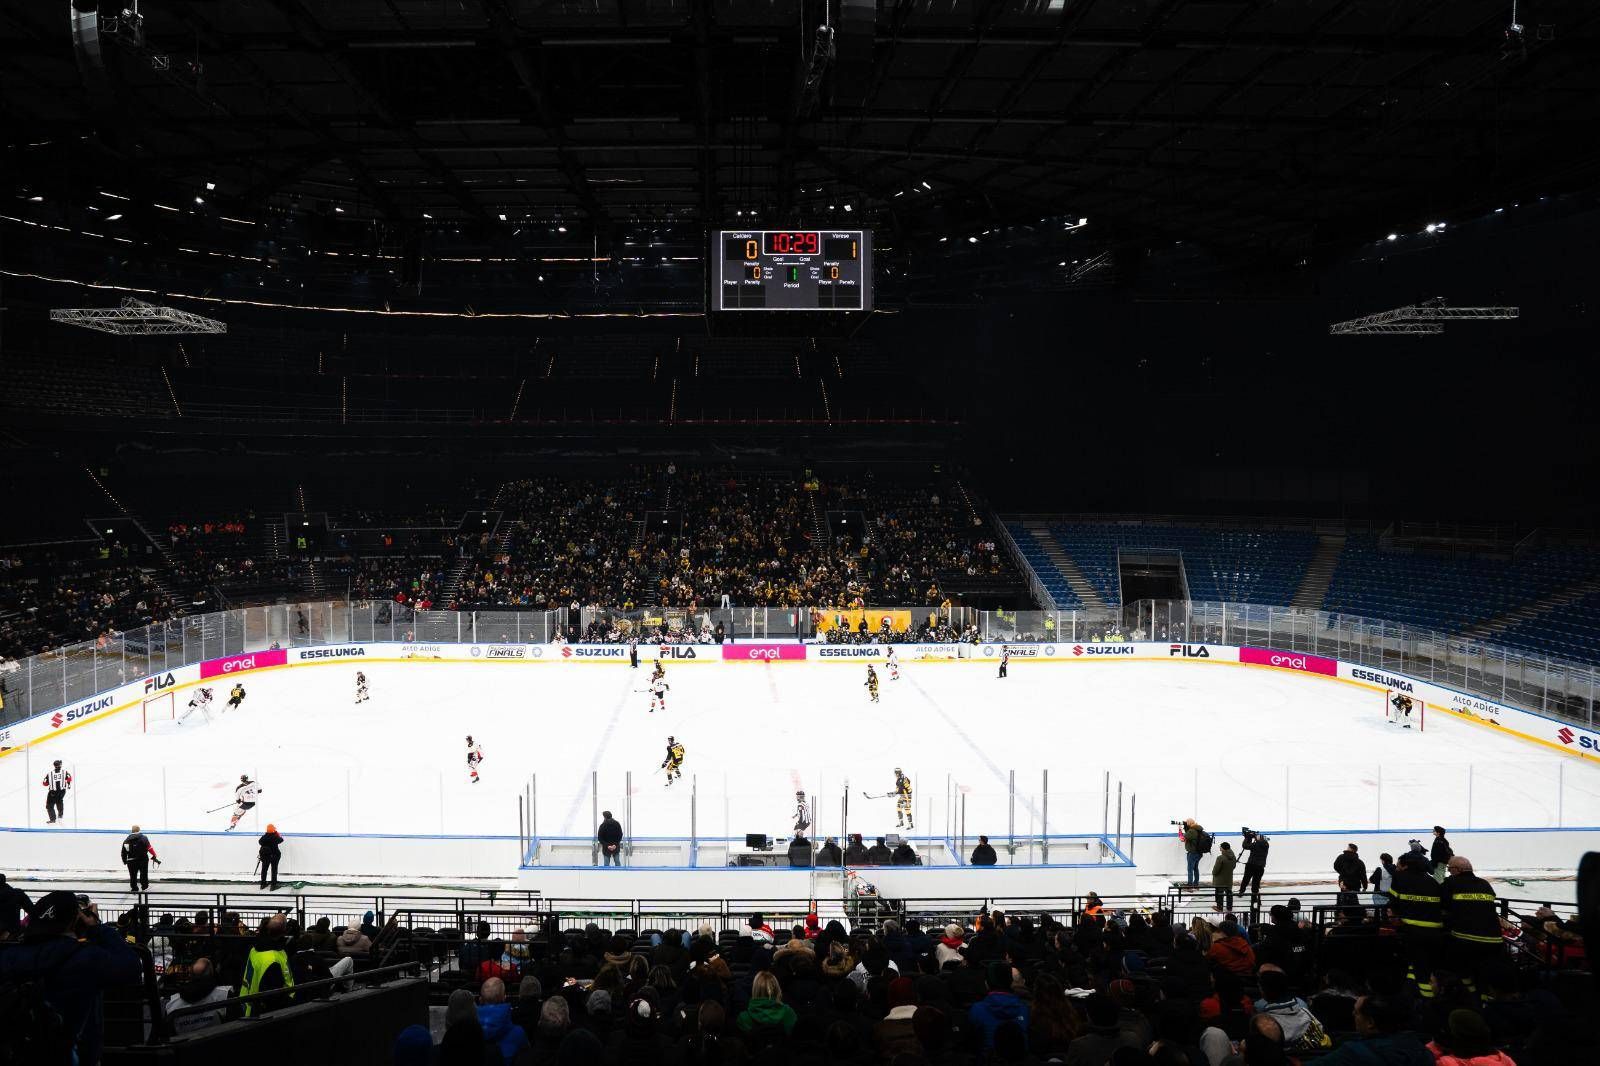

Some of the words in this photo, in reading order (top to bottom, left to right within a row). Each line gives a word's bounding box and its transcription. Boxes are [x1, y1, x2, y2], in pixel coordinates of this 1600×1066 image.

[774, 234, 816, 252] 10:29
[746, 240, 758, 259] 0
[754, 267, 761, 279] 0
[831, 267, 838, 279] 0
[300, 647, 365, 659] ESSELUNGA
[576, 648, 624, 657] SUZUKI
[749, 647, 780, 659] enel
[819, 648, 880, 657] ESSELUNGA
[1086, 646, 1134, 655] SUZUKI
[1170, 644, 1209, 657] FILA
[222, 656, 256, 672] enel
[1270, 654, 1307, 669] enel
[145, 673, 175, 694] FILA
[1352, 668, 1413, 693] ESSELUNGA
[1453, 695, 1471, 706] ALTO
[66, 696, 113, 721] SUZUKI
